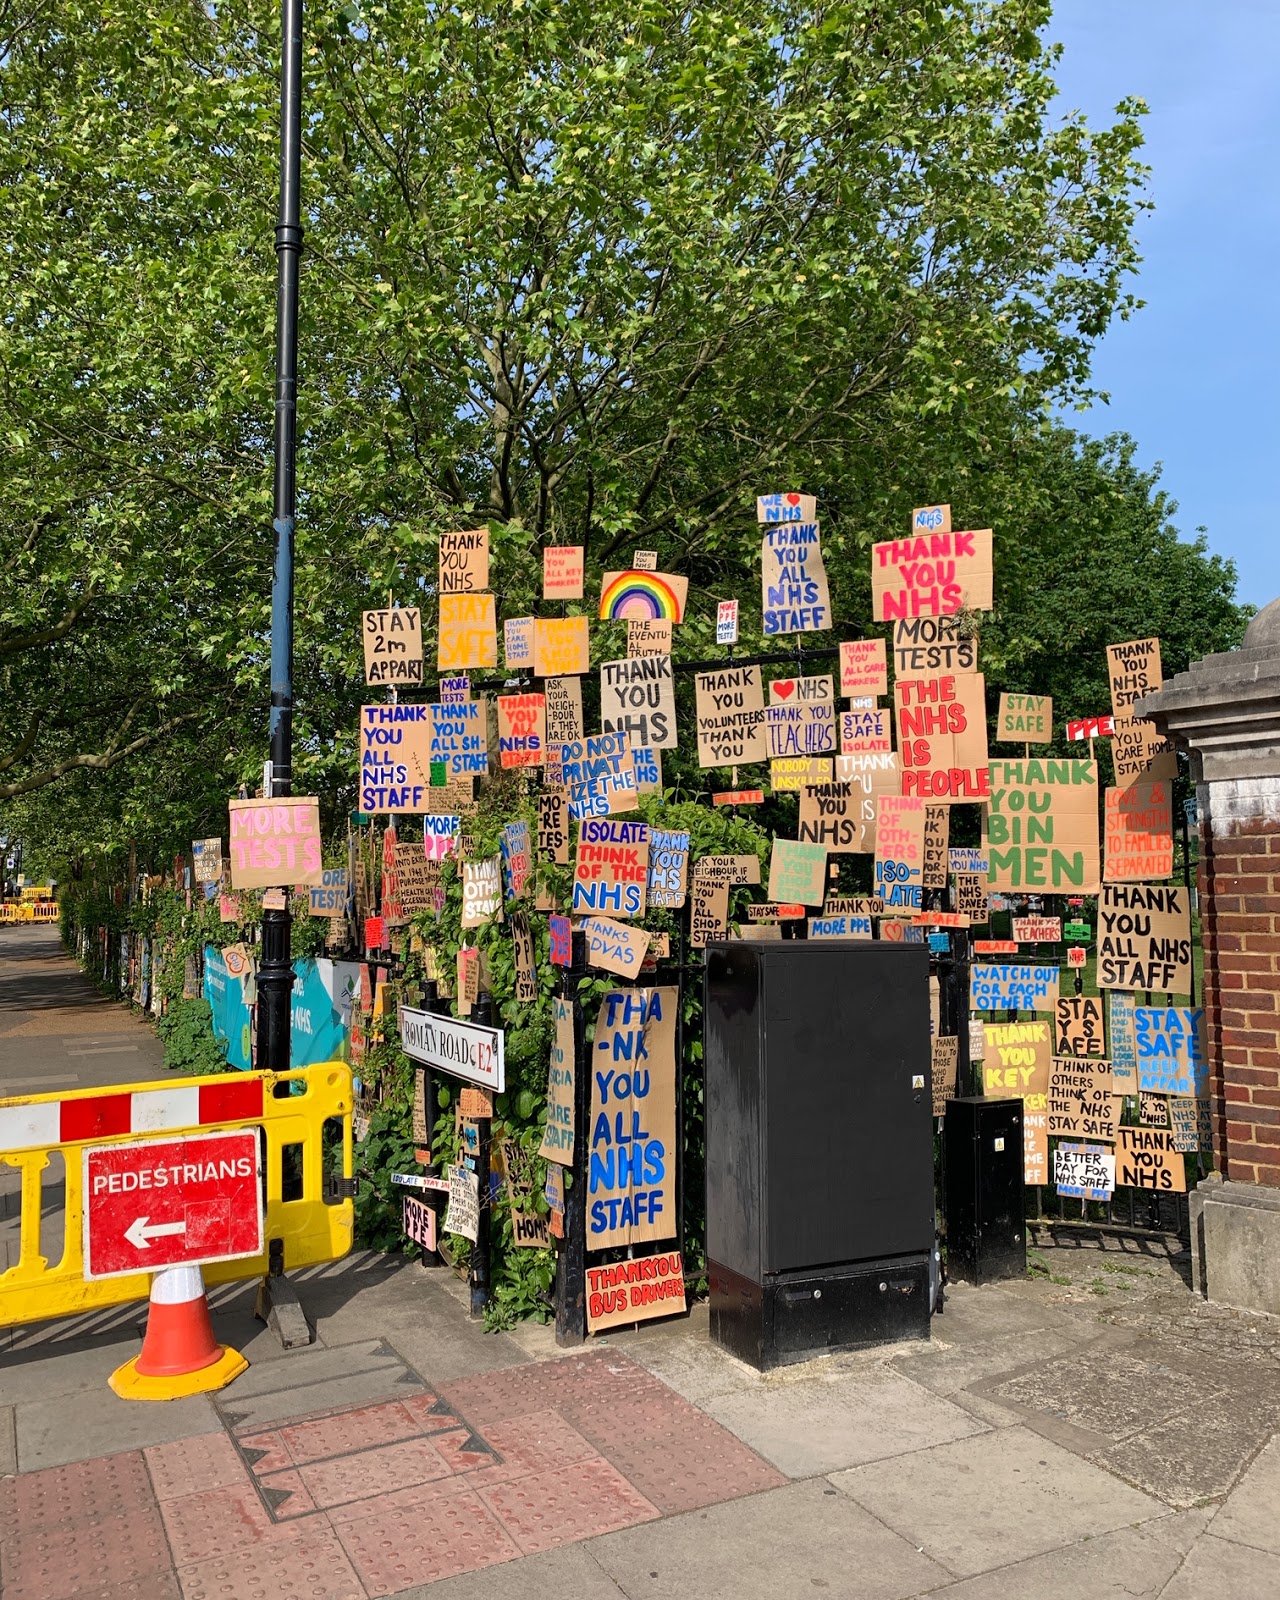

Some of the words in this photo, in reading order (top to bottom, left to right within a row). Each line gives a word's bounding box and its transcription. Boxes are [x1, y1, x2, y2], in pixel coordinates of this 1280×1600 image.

[761, 495, 782, 505] WE
[766, 507, 802, 521] NHS
[915, 512, 944, 527] NHS
[440, 534, 483, 550] THANK
[767, 525, 818, 546] THANK
[546, 548, 577, 557] THANK
[774, 548, 808, 565] YOU
[876, 533, 975, 566] THANK
[441, 552, 468, 570] YOU
[546, 558, 565, 567] YOU
[443, 572, 473, 590] NHS
[546, 569, 562, 577] ALL
[566, 568, 582, 576] KEY
[778, 567, 811, 583] ALL
[899, 561, 955, 589] YOU
[768, 583, 818, 606] NHS
[883, 584, 962, 620] NHS
[440, 595, 492, 623] STAY
[366, 611, 417, 633] STAY
[629, 621, 650, 630] THE
[764, 607, 825, 634] STAFF
[374, 635, 406, 653] 2m
[629, 631, 670, 640] EVENTU-
[506, 643, 528, 651] HOME
[507, 651, 529, 659] STAFF
[842, 643, 876, 654] THANK
[1110, 642, 1155, 660] THANK
[895, 645, 973, 670] TESTS
[1122, 658, 1147, 673] YOU
[603, 656, 671, 685] THANK
[442, 677, 469, 692] MORE
[547, 680, 563, 690] ASK
[698, 669, 753, 691] THANK
[1114, 674, 1148, 691] NHS
[547, 690, 568, 700] YOUR
[615, 684, 660, 708] YOU
[797, 680, 828, 699] NHS
[896, 676, 955, 705] THE
[712, 693, 743, 710] YOU
[1007, 695, 1045, 711] STAY
[364, 706, 427, 723] THANK
[431, 704, 479, 720] THANK
[700, 709, 765, 729] VOLUNTEERS
[766, 706, 803, 721] THANK
[809, 706, 832, 719] YOU
[844, 712, 882, 725] STAY
[899, 703, 967, 738] NHS
[433, 722, 465, 737] YOU
[844, 725, 884, 739] SAFE
[1005, 715, 1043, 733] SAFE
[1068, 716, 1114, 741] PPE
[363, 729, 402, 746] YOU
[500, 736, 540, 750] NHS
[699, 726, 757, 744] THANK
[767, 722, 833, 755] TEACHERS
[1114, 733, 1142, 747] YOU
[431, 739, 458, 751] ALL
[562, 742, 583, 763] DO
[587, 732, 627, 757] NOT
[711, 745, 743, 760] YOU
[843, 741, 889, 752] ISOLATE
[903, 739, 931, 767] IS
[1116, 745, 1143, 761] CARE
[362, 750, 394, 766] ALL
[771, 759, 813, 773] NOBODY
[818, 760, 829, 773] IS
[841, 755, 896, 772] THANK
[363, 765, 408, 786] NHS
[563, 752, 624, 785] PRIVAT
[989, 759, 1096, 785] THANK
[1118, 760, 1153, 776] STAFF
[599, 771, 635, 794] THE
[805, 783, 852, 798] THANK
[902, 768, 990, 797] PEOPLE
[363, 786, 425, 811] STAFF
[817, 797, 847, 816] YOU
[879, 797, 923, 811] THINK
[989, 789, 1051, 813] YOU
[1106, 788, 1138, 808] LOVE
[568, 796, 610, 820] NHS
[232, 806, 313, 837] MORE
[988, 815, 1053, 845] BIN
[582, 821, 649, 844] ISOLATE
[800, 820, 856, 846] NHS
[1106, 836, 1122, 853] TO
[1124, 832, 1172, 852] FAMILIES
[231, 837, 321, 872] TESTS
[579, 845, 638, 865] THINK
[949, 849, 981, 859] THANK
[578, 864, 603, 880] OF
[611, 865, 647, 881] THE
[950, 861, 966, 871] YOU
[969, 860, 988, 871] NHS
[988, 848, 1084, 887] MEN
[1106, 855, 1171, 877] SEPARATED
[695, 880, 724, 889] THANK
[959, 876, 978, 885] THE
[310, 889, 345, 911] TESTS
[573, 881, 641, 913] NHS
[959, 887, 982, 898] NHS
[1102, 885, 1181, 913] THANK
[694, 908, 714, 918] ALL
[826, 900, 863, 913] THANK
[867, 900, 884, 913] YOU
[959, 899, 988, 909] SAVES
[693, 918, 721, 929] SHOP
[813, 919, 846, 935] MORE
[851, 919, 870, 933] PPE
[1101, 911, 1151, 936] YOU
[1069, 953, 1084, 962] NHS
[1100, 937, 1139, 958] ALL
[1150, 938, 1190, 965] NHS
[974, 967, 1031, 983] WATCH
[1034, 967, 1060, 984] OUT
[1102, 959, 1176, 988] STAFF
[972, 981, 1002, 996] FOR
[1008, 983, 1047, 997] EACH
[605, 992, 662, 1028] THA
[977, 995, 1035, 1010] OTHER
[1134, 1008, 1203, 1033] STAY
[984, 1024, 1048, 1047] THANK
[405, 1021, 437, 1054] ROMAN
[439, 1032, 469, 1065] ROAD
[478, 1042, 492, 1073] E2
[1137, 1033, 1202, 1060] SAFE
[998, 1047, 1036, 1066] YOU
[1053, 1060, 1094, 1074] THINK
[1097, 1062, 1113, 1074] OF
[596, 1069, 650, 1104] YOU
[986, 1066, 1036, 1089] KEY
[1052, 1075, 1093, 1088] OTHERS
[1050, 1087, 1087, 1101] THINK
[1093, 1089, 1111, 1101] OF
[1049, 1100, 1071, 1112] THE
[1080, 1102, 1112, 1118] NHS
[593, 1111, 649, 1148] ALL
[1049, 1116, 1079, 1130] STAY
[1083, 1119, 1114, 1137] SAFE
[1119, 1129, 1174, 1151] THANK
[589, 1140, 665, 1194] NHS
[1056, 1151, 1101, 1165] BETTER
[1130, 1151, 1163, 1168] YOU
[94, 1158, 251, 1195] PEDESTRIANS
[1056, 1163, 1078, 1175] PAY
[1085, 1166, 1107, 1178] FOR
[1123, 1165, 1173, 1190] NHS
[1055, 1173, 1077, 1185] NHS
[1080, 1176, 1110, 1189] STAFF
[405, 1199, 428, 1229] MORE
[591, 1190, 663, 1233] STAFF
[405, 1217, 427, 1246] PPE
[589, 1289, 627, 1318] BUS
[631, 1278, 684, 1307] DRIVERS
